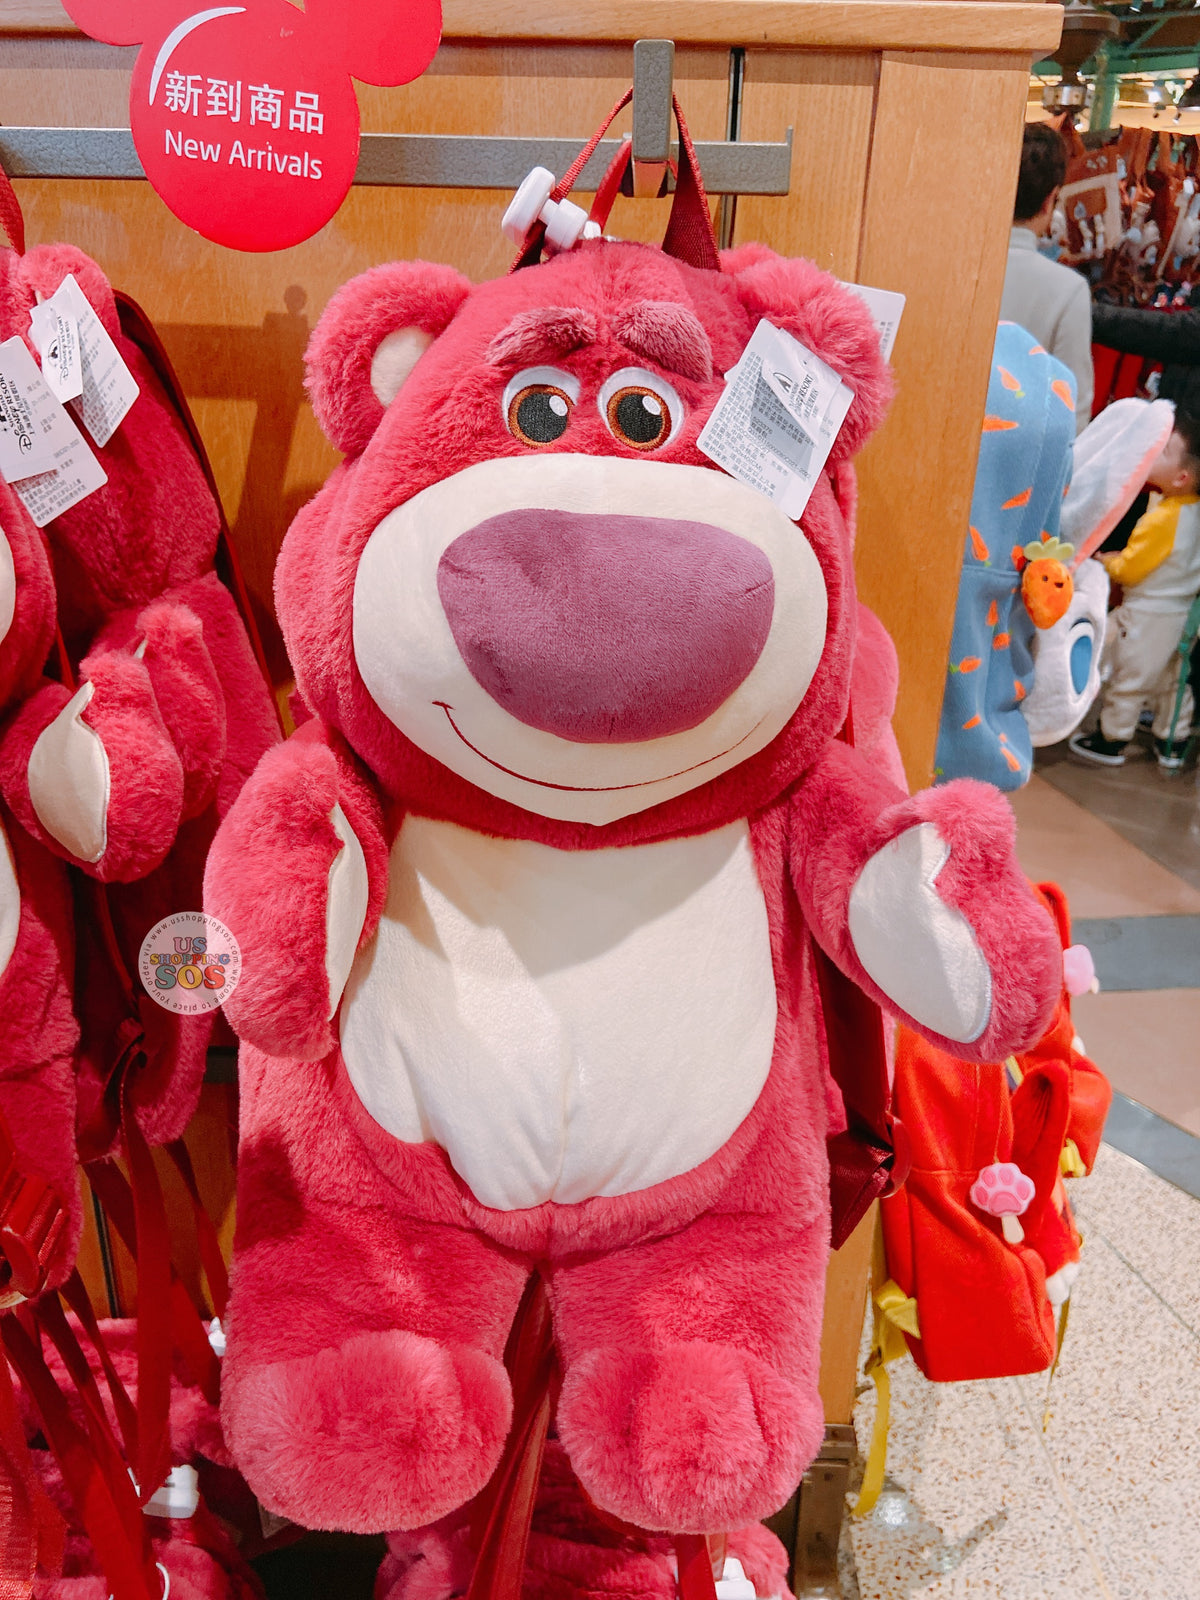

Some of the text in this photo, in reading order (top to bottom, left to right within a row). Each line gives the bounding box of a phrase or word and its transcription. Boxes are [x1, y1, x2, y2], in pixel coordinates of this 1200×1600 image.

[164, 70, 324, 135] 新到商品
[165, 129, 322, 180] New Arrivals
